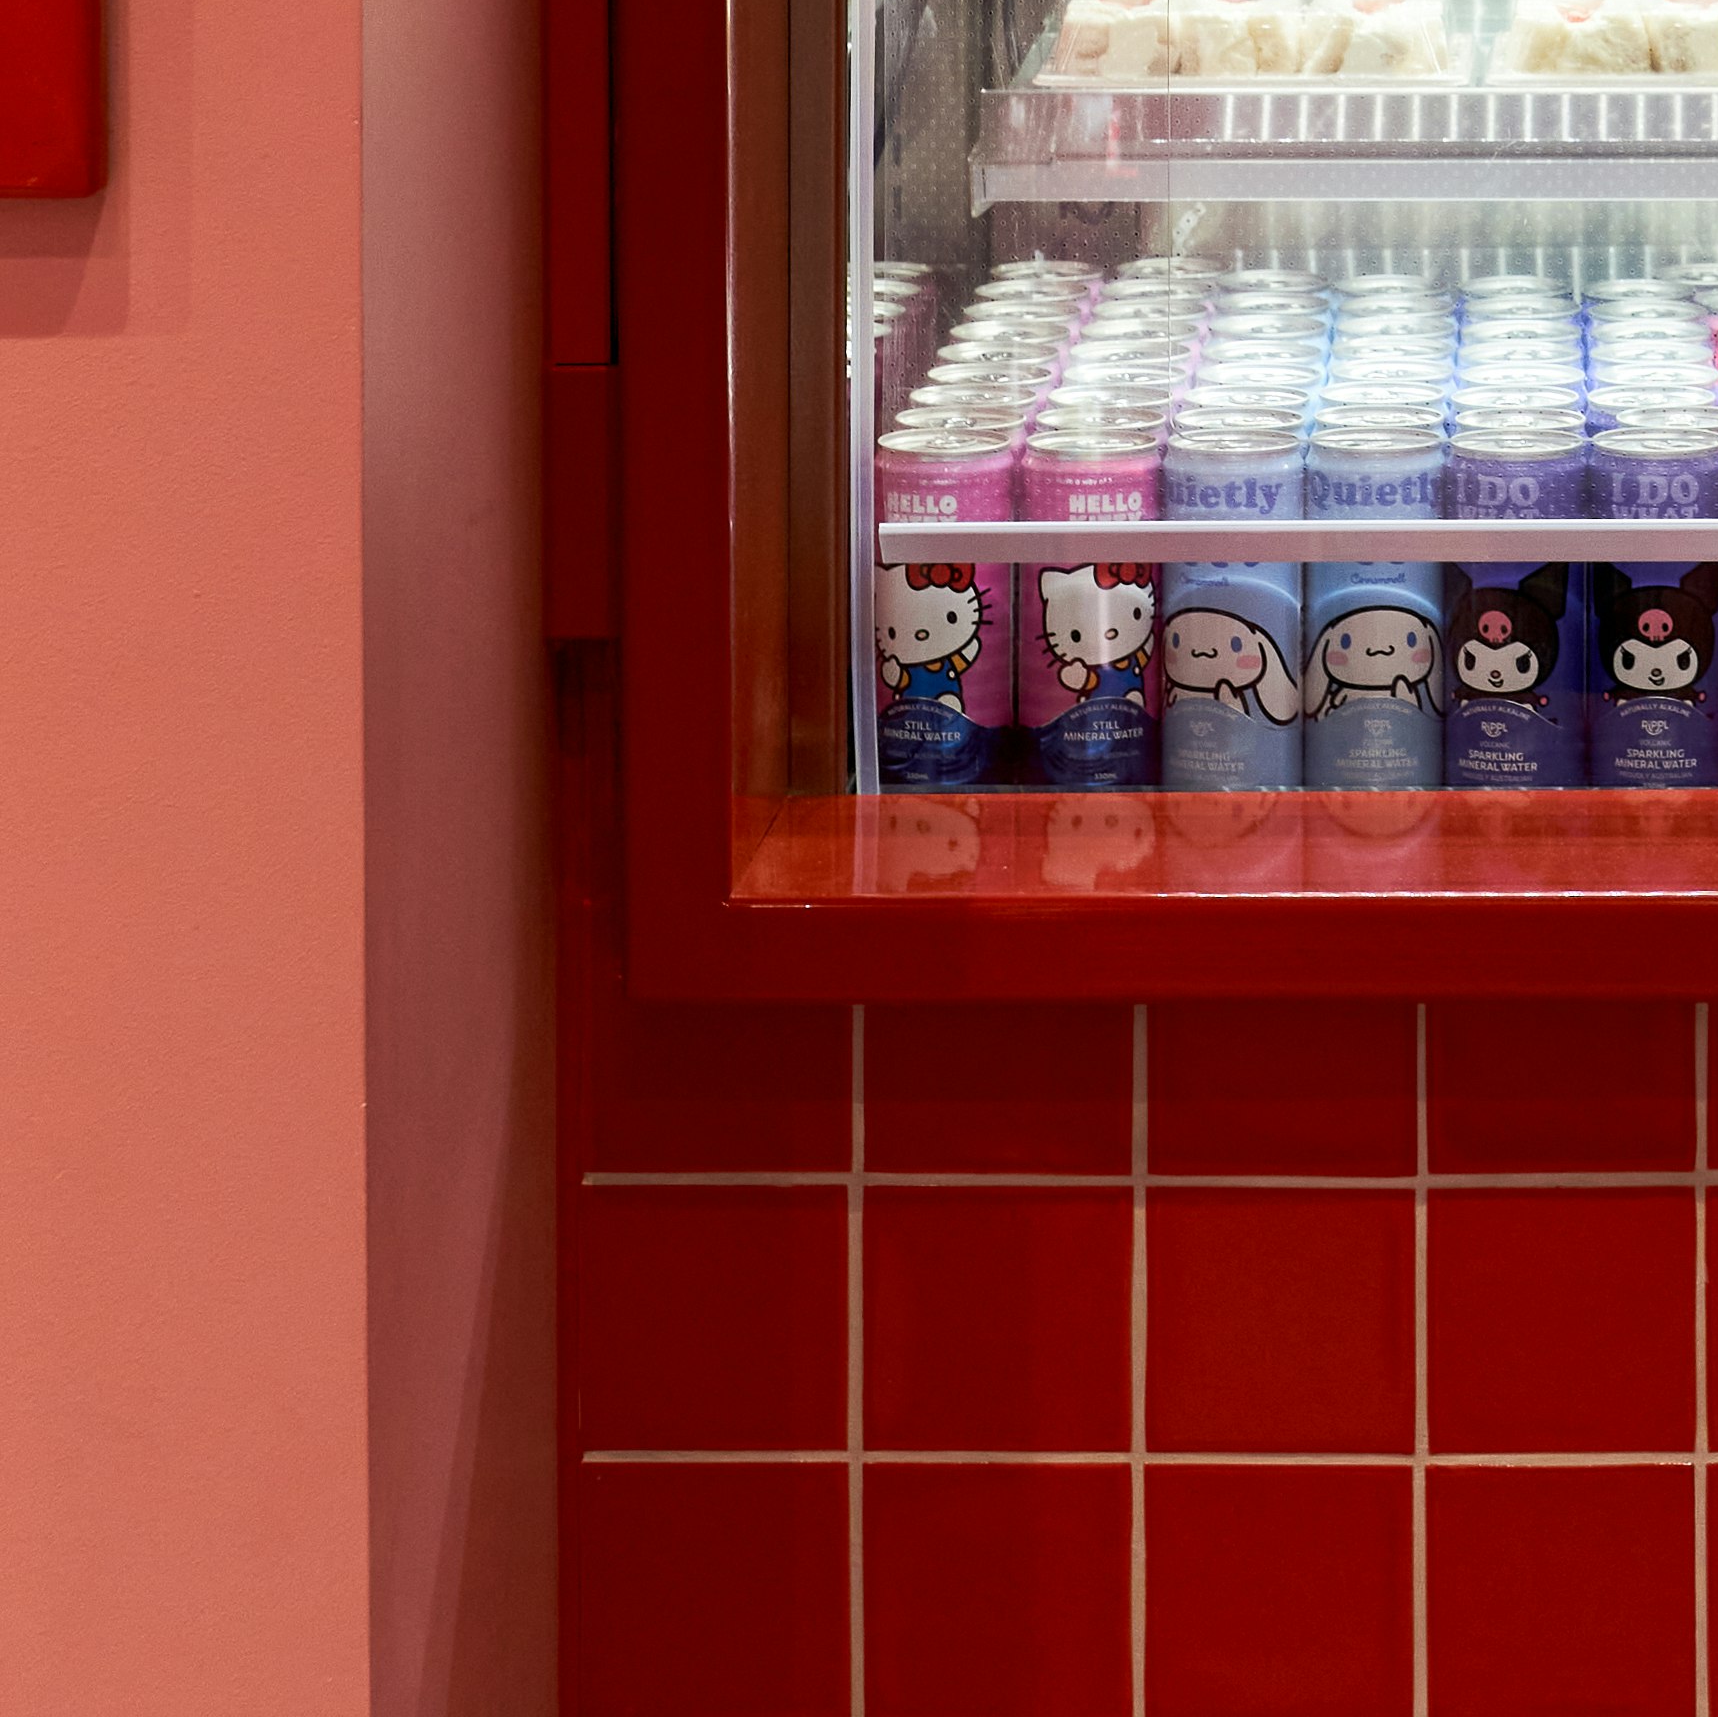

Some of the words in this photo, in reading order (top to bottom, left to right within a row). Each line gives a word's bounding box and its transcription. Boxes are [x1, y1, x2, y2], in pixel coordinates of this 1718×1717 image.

[1166, 476, 1283, 514] uietly
[1478, 474, 1540, 506] DO
[1612, 472, 1624, 503] I
[1636, 474, 1699, 505] DO
[887, 492, 957, 514] HELLO
[1069, 491, 1142, 513] HELLO
[905, 720, 932, 731] STILL
[1092, 720, 1120, 731] STILL
[924, 732, 961, 742] WATER
[1063, 731, 1112, 741] MINERAL
[1112, 727, 1144, 740] WATER
[1468, 749, 1525, 762] SPARKLING
[1626, 748, 1685, 759] SPARKLING
[1459, 758, 1500, 772] MINERAL
[1500, 762, 1538, 772] WATER
[1614, 757, 1662, 770] MINERAL
[1662, 758, 1698, 770] WATER
